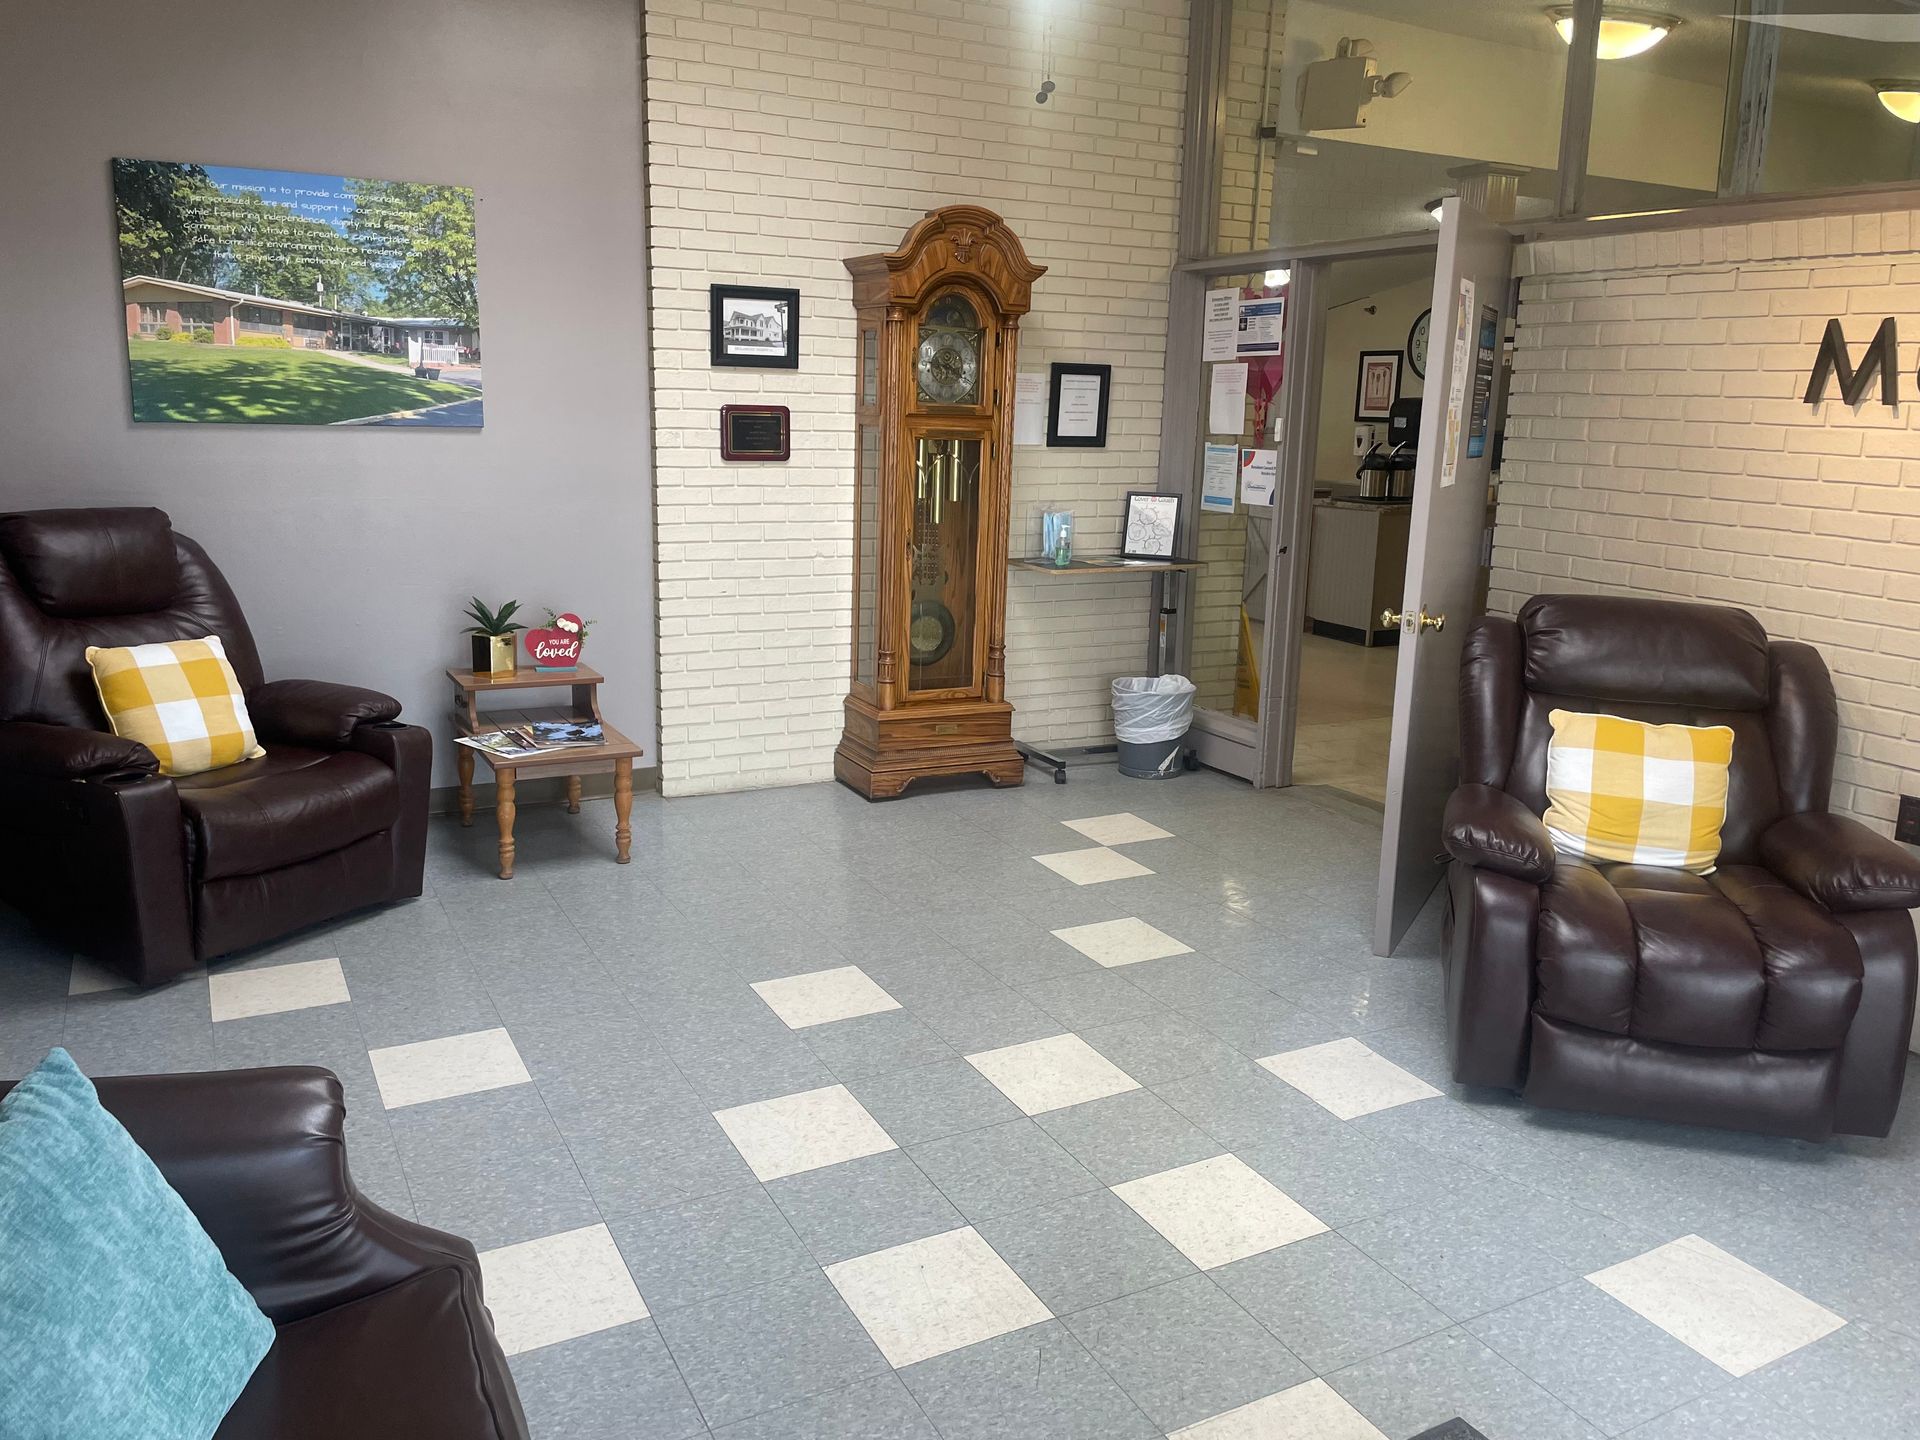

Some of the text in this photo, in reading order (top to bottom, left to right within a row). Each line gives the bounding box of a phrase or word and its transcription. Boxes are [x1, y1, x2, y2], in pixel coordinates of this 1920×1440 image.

[232, 183, 266, 192] mission
[281, 186, 291, 194] to
[295, 188, 330, 200] provide
[190, 196, 250, 206] personalized
[254, 199, 277, 207] care
[281, 200, 298, 209] and
[300, 202, 338, 214] support
[342, 204, 352, 213] to
[186, 207, 210, 216] while
[214, 206, 260, 223] fostering
[364, 218, 381, 228] and
[384, 222, 410, 232] sense
[413, 222, 425, 232] of
[240, 224, 258, 234] We
[261, 226, 289, 236] strive
[293, 228, 304, 236] to
[307, 230, 340, 240] create
[352, 232, 410, 245] comfortable
[413, 237, 429, 246] and
[192, 234, 215, 245] safe
[267, 241, 324, 252] environment
[328, 246, 358, 254] where
[361, 248, 403, 257] residents
[406, 250, 423, 258] can
[213, 250, 242, 260] thrive
[351, 258, 366, 268] and
[1415, 339, 1421, 348] 9
[1416, 352, 1422, 362] 8
[1802, 316, 1920, 407] M
[534, 641, 579, 659] loved
